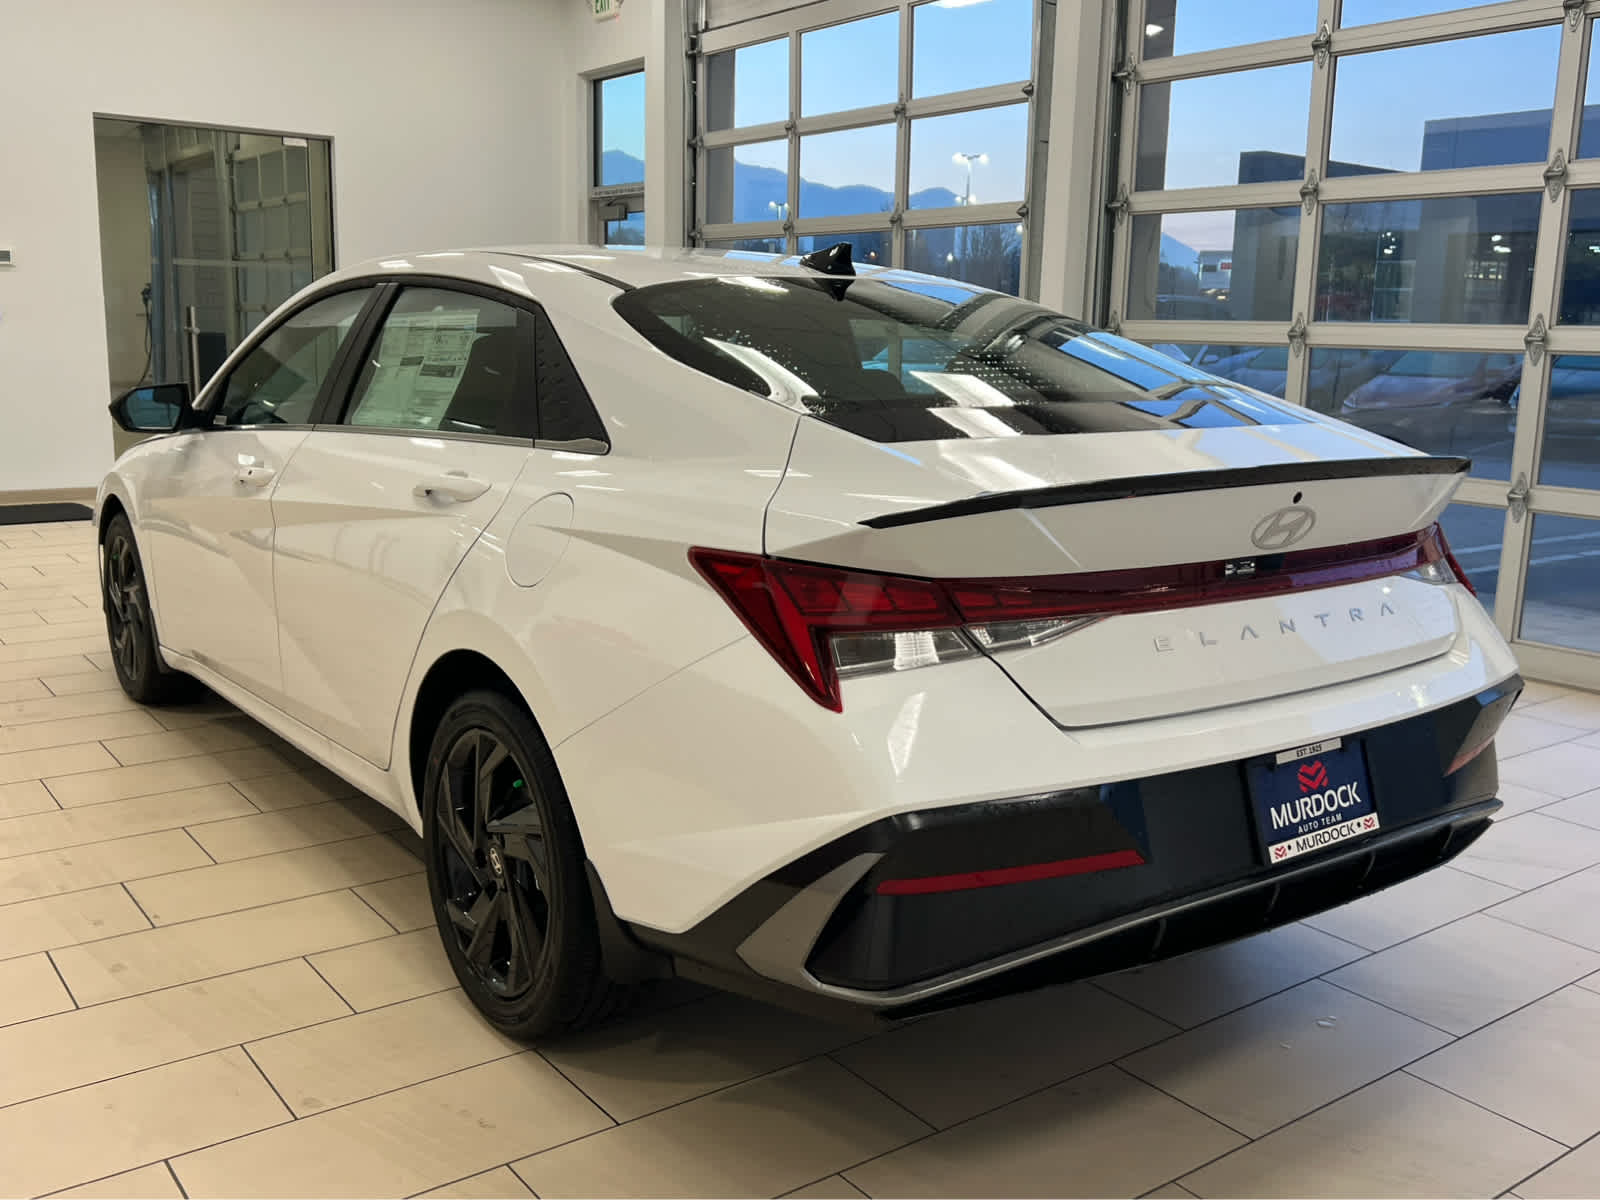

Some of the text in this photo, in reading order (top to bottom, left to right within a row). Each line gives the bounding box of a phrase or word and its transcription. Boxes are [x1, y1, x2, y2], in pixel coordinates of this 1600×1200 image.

[1153, 602, 1395, 652] ELANTRA
[1270, 781, 1362, 830] MURDOCK
[1298, 813, 1342, 834] AUTO TEAM
[1296, 823, 1356, 852] MURDOCK
